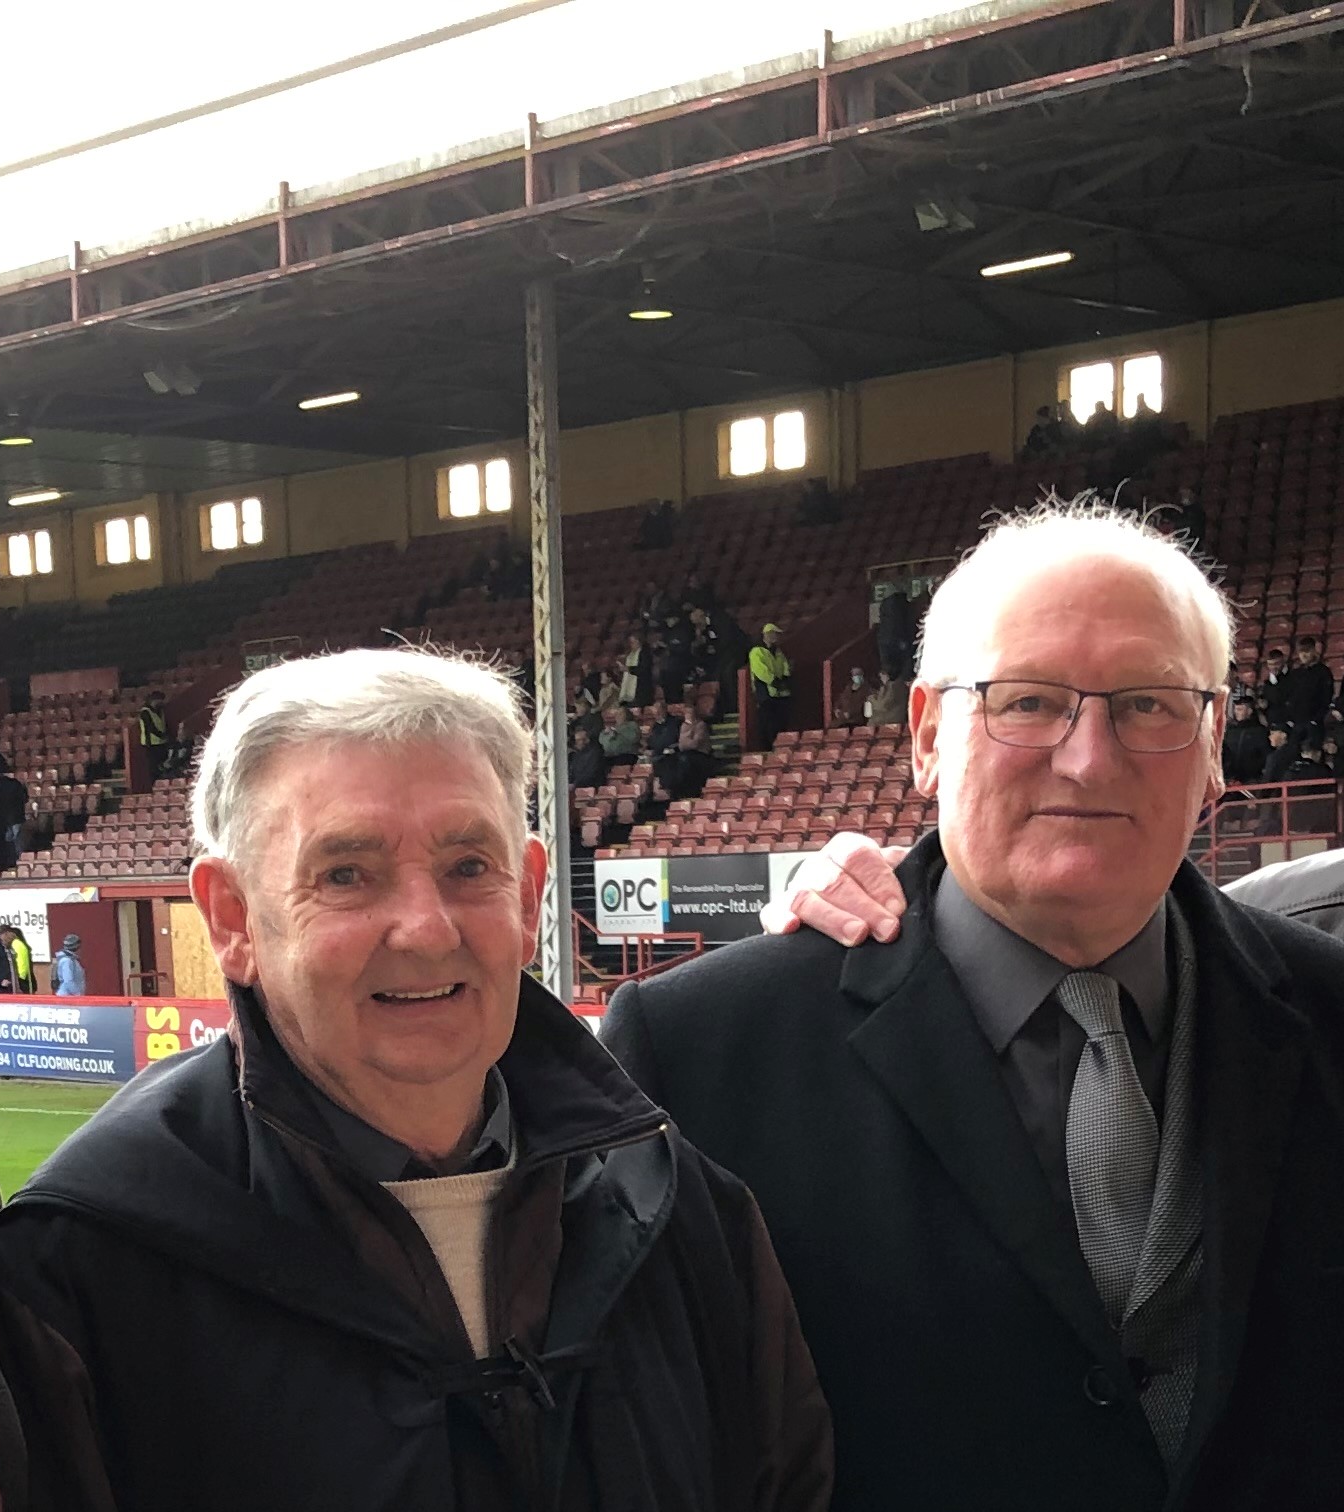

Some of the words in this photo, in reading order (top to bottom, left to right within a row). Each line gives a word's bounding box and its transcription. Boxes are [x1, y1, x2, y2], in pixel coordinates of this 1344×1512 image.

[601, 878, 657, 912] OPC
[11, 1024, 88, 1044] CONTRACTOR
[17, 1054, 116, 1074] CLFLOORING.CO.UK
